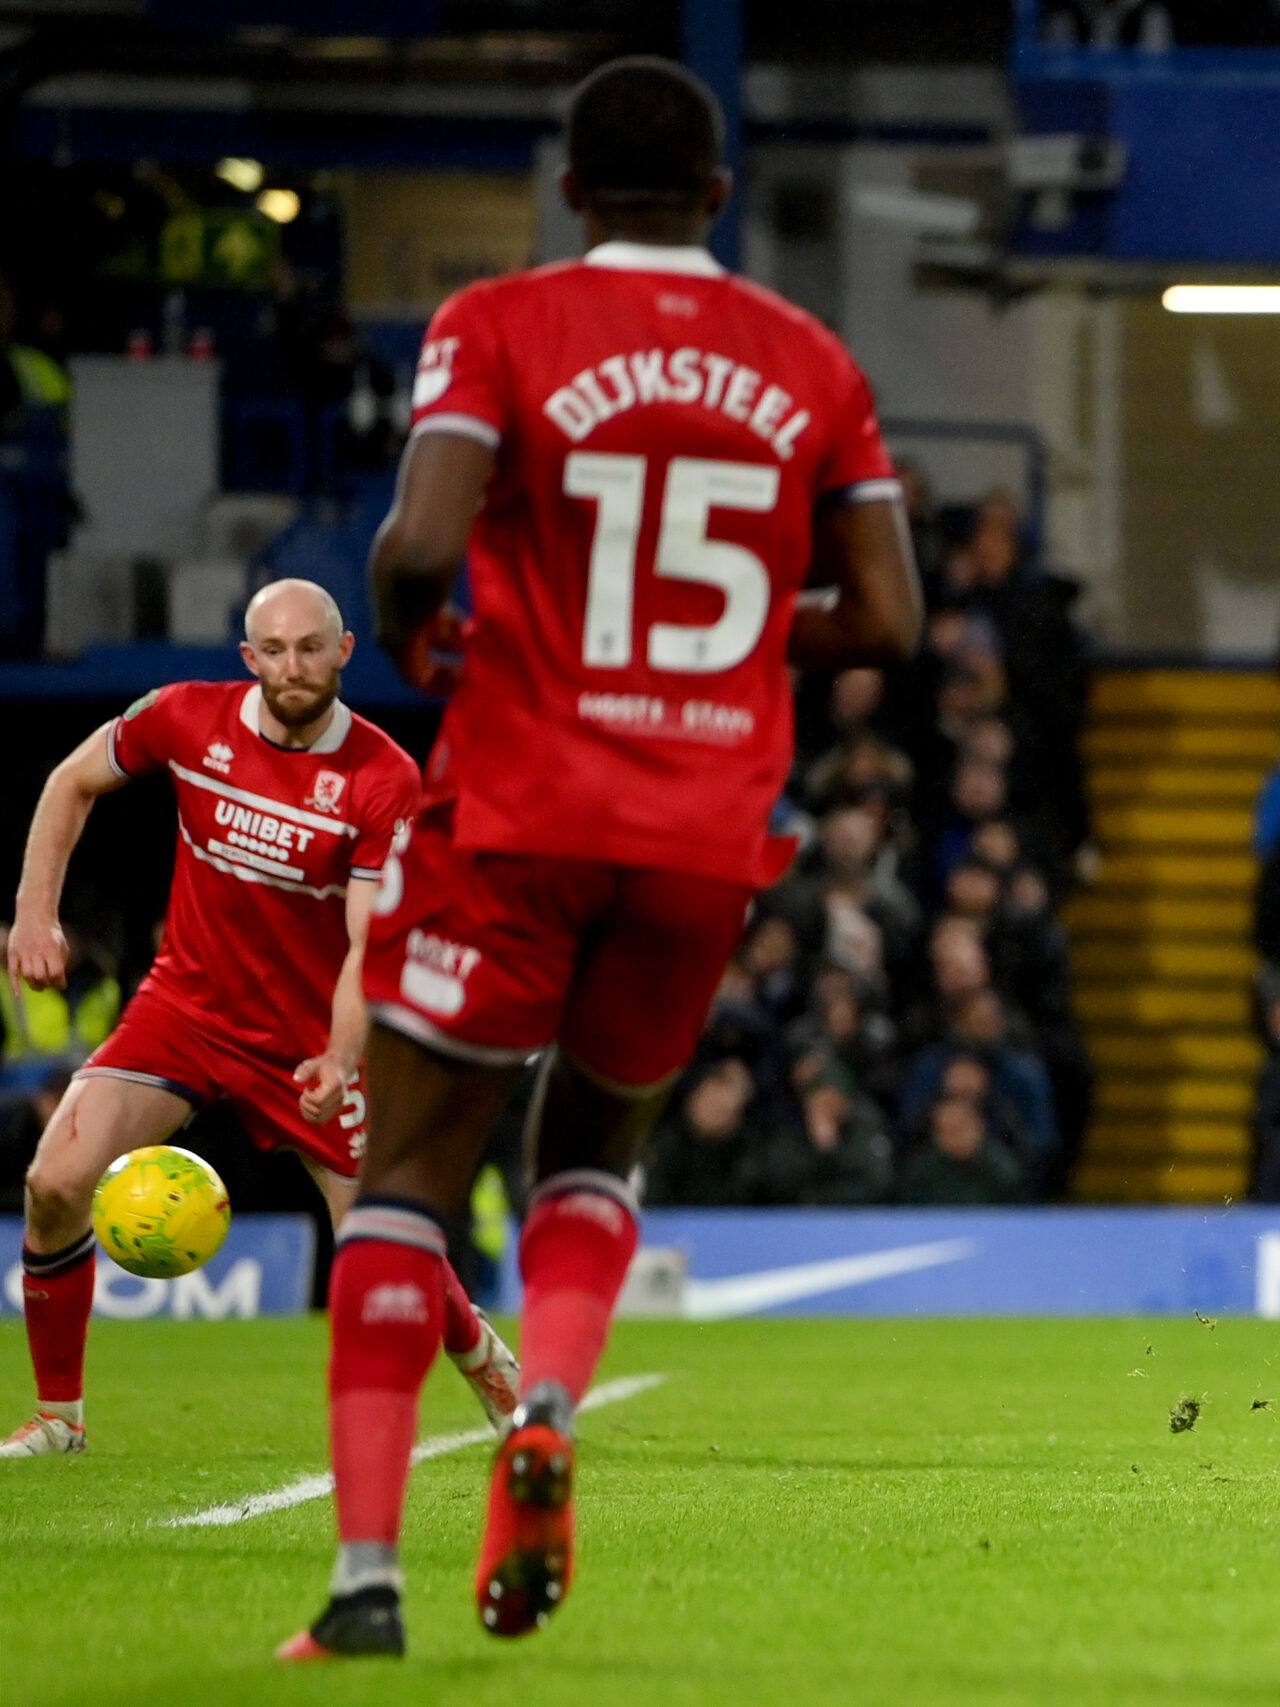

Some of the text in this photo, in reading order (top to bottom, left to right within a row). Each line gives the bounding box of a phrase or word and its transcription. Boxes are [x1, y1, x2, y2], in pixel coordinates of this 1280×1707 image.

[543, 347, 811, 460] DIJKSTEEL
[562, 451, 781, 674] 15
[214, 799, 315, 853] UNIBET
